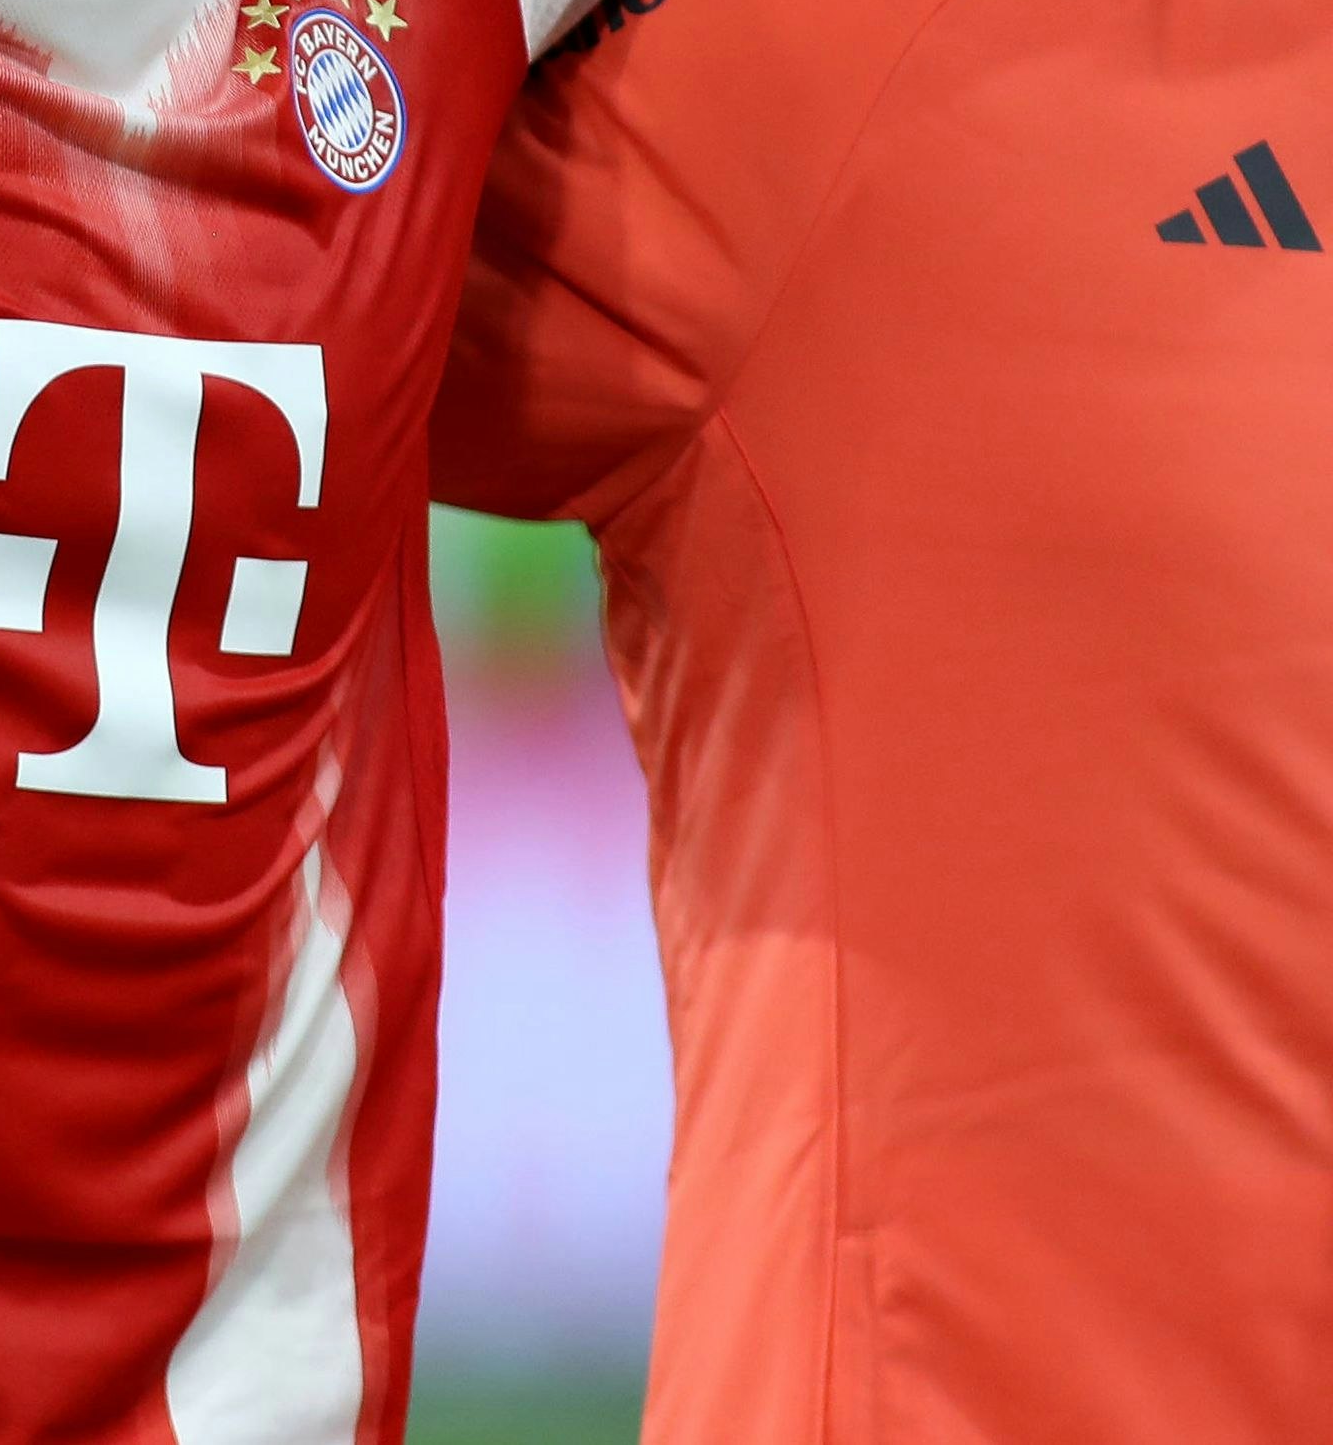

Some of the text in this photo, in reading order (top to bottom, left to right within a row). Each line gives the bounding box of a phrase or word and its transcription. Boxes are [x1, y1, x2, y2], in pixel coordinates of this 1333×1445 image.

[293, 22, 378, 96] FC BAYERN
[308, 109, 395, 180] MÜNCHEN
